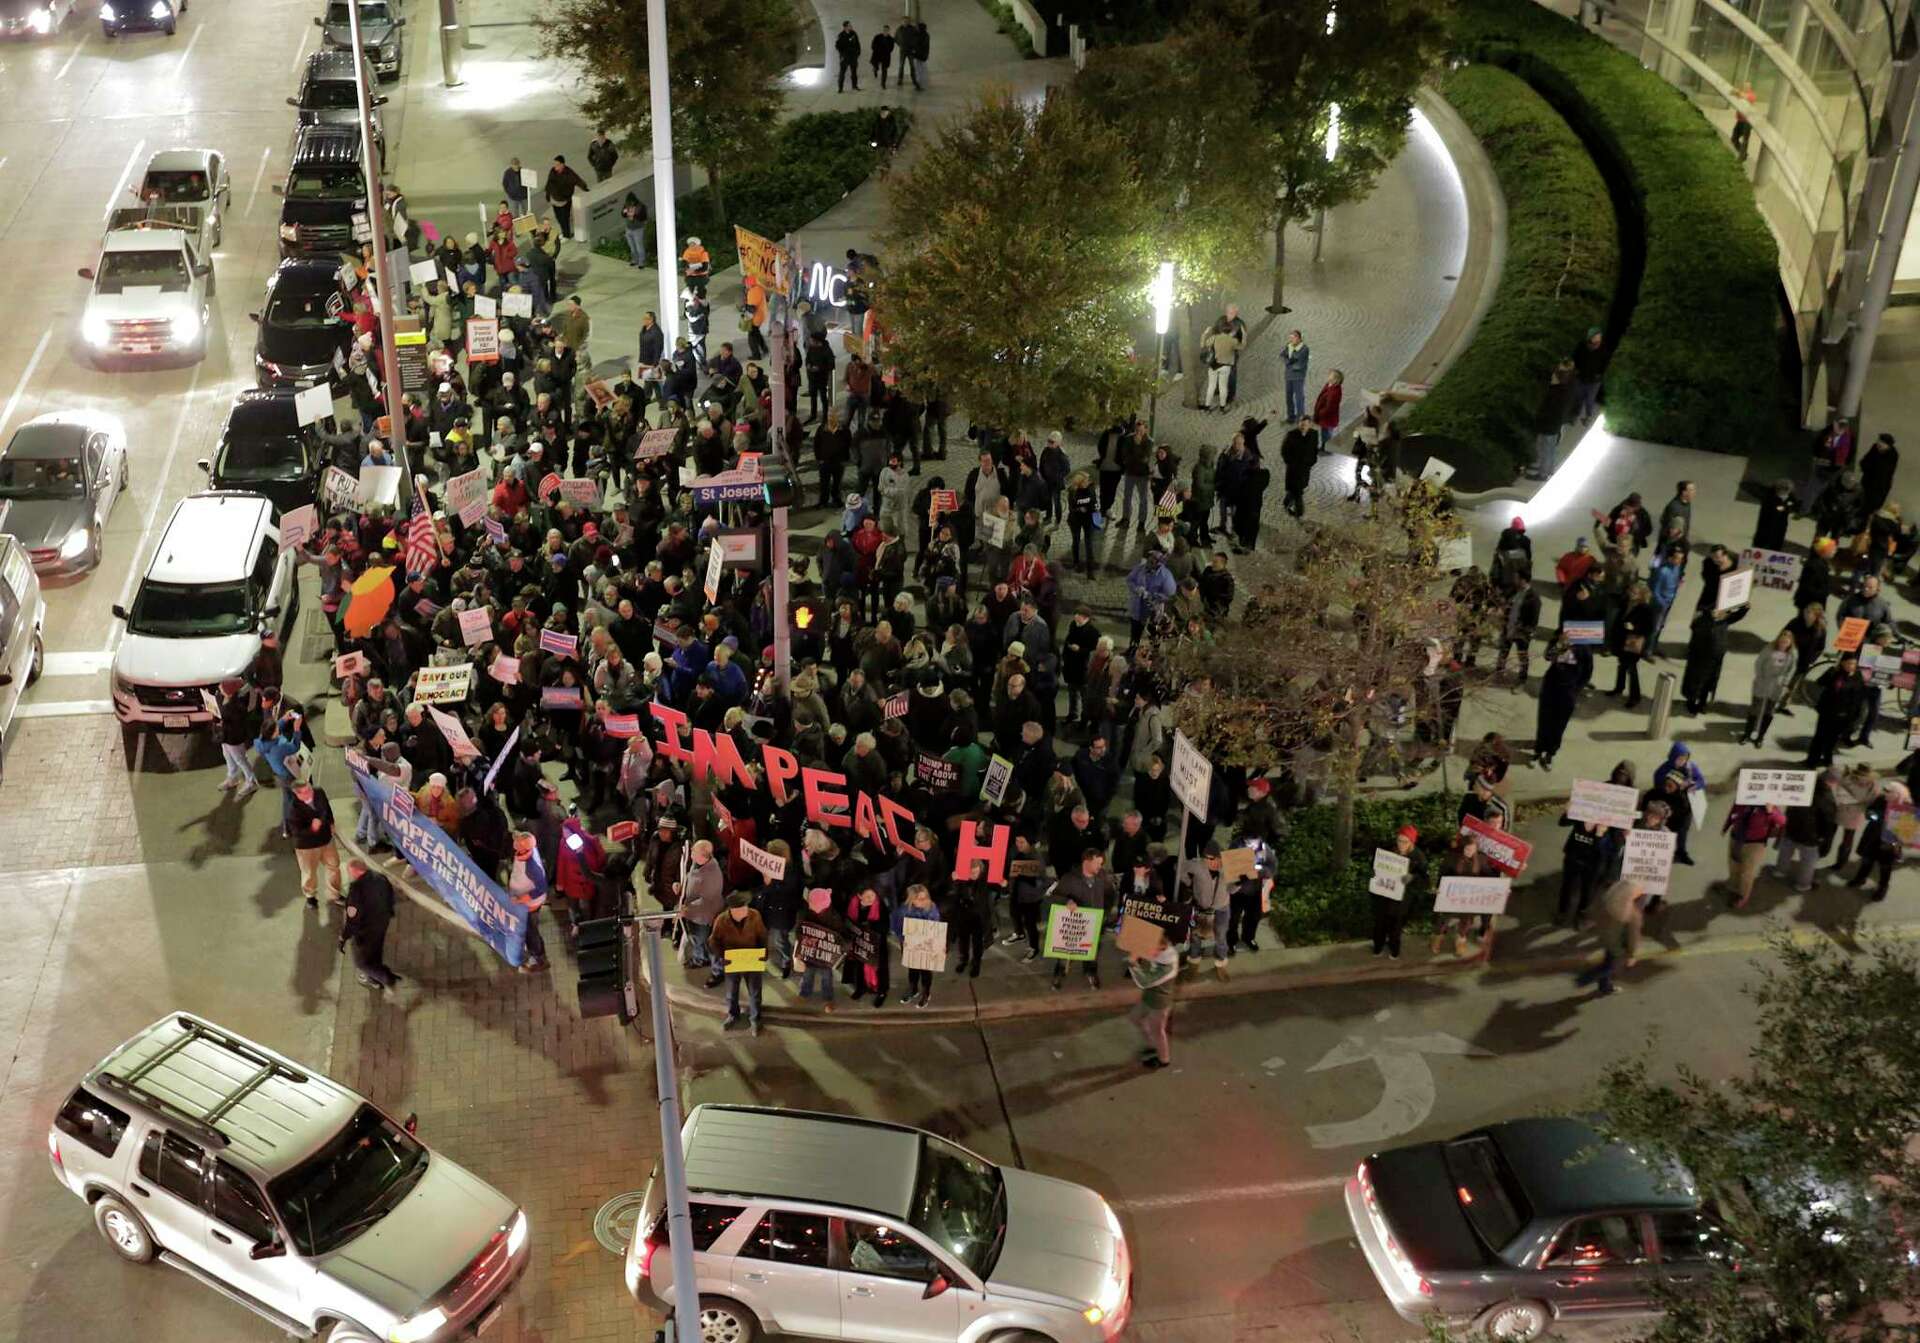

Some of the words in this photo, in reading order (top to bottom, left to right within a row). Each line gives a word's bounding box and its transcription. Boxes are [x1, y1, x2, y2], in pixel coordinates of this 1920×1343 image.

[330, 468, 360, 493] TRUT
[701, 488, 715, 500] St
[421, 673, 447, 683] SAVE
[449, 670, 469, 680] OUR
[919, 755, 943, 770] TRUMP
[944, 762, 953, 772] IS
[932, 769, 957, 781] ABOVE
[1180, 762, 1199, 789] MUST
[382, 801, 521, 933] IMPEACHMENT
[402, 836, 429, 864] FOR
[431, 855, 456, 887] THE
[456, 880, 496, 930] PEOPLE
[1124, 906, 1181, 924] DEMOCRACY
[1125, 899, 1163, 913] DEFEND
[801, 925, 827, 940] TRUMP
[827, 932, 836, 944] IS
[800, 944, 816, 958] THE
[816, 950, 833, 963] LAW
[818, 939, 842, 956] ABOVE
